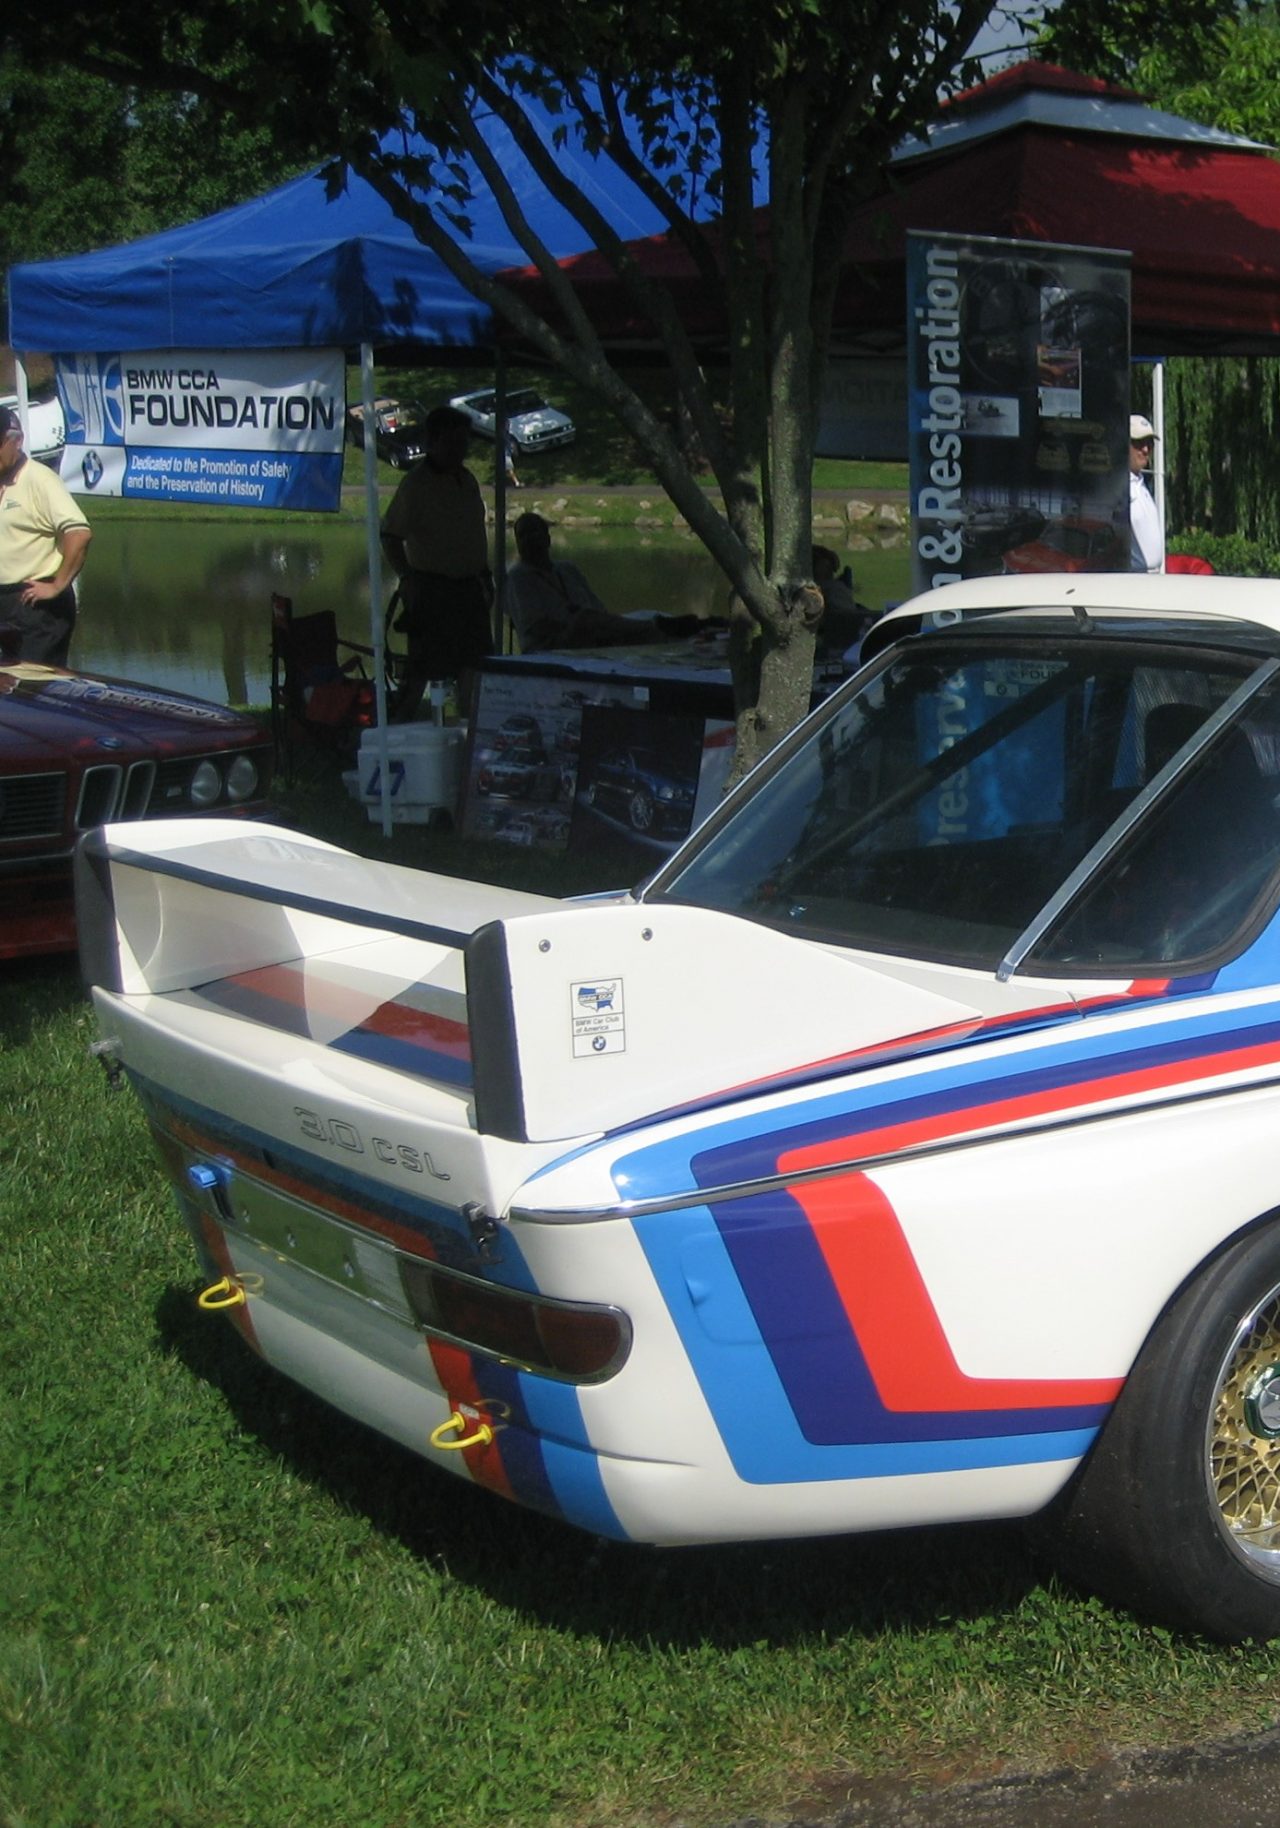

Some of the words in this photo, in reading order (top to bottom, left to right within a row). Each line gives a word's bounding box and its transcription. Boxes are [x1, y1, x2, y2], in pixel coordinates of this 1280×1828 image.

[127, 370, 174, 389] BMW
[178, 370, 220, 390] CCA
[915, 249, 963, 518] Restoration
[130, 394, 334, 430] FOUNDATION
[131, 455, 172, 471] Dedicated
[173, 458, 183, 472] to
[184, 458, 198, 473] the
[200, 459, 248, 476] Promotion
[250, 461, 260, 476] of
[127, 475, 144, 488] and
[145, 474, 159, 490] the
[161, 475, 217, 494] Preservation
[218, 478, 229, 493] of
[230, 480, 265, 500] History
[918, 528, 963, 564] &
[372, 1137, 451, 1181] CSL
